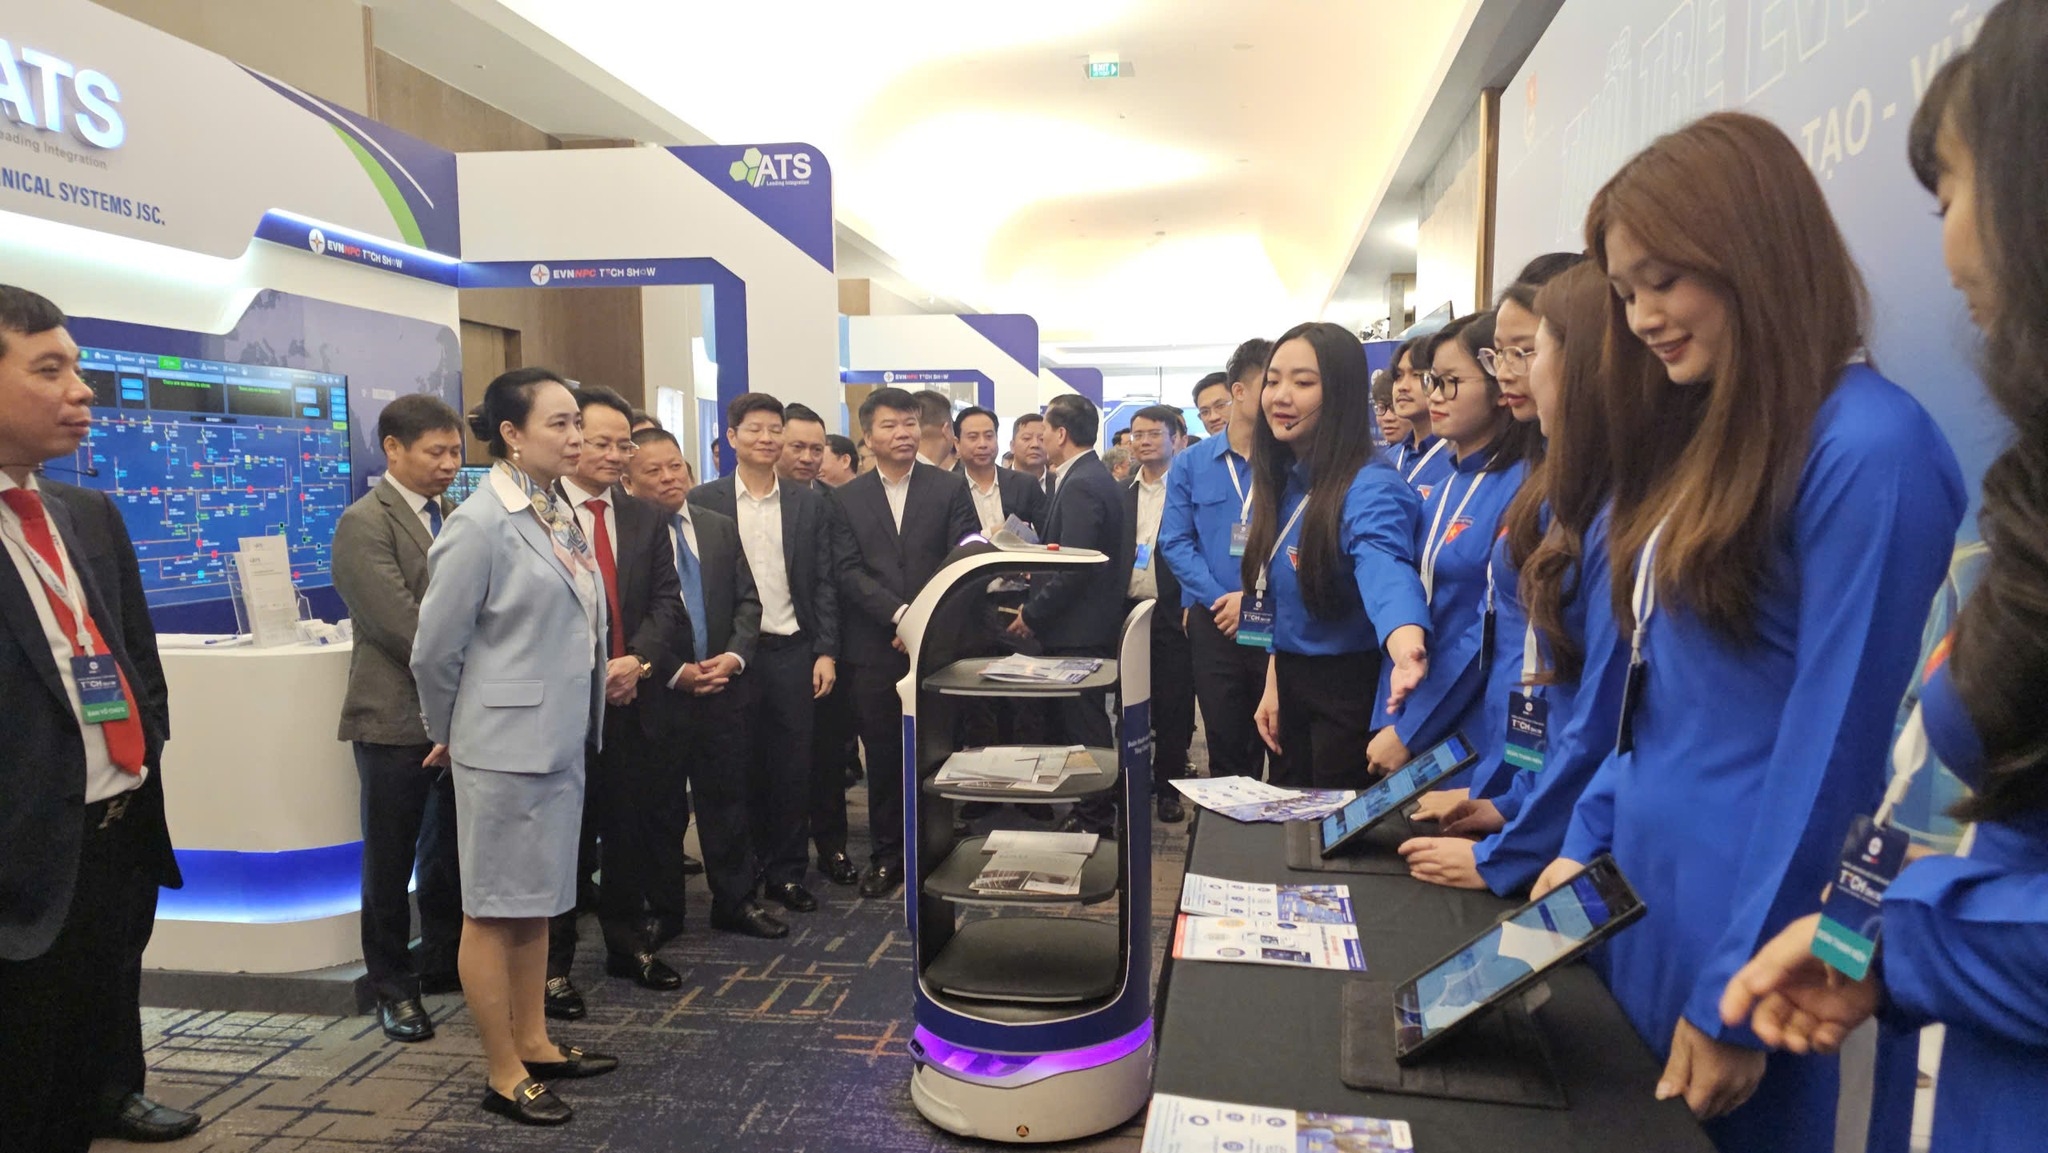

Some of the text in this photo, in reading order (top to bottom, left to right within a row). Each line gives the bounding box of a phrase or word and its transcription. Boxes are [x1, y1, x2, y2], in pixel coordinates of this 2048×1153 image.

[0, 38, 126, 150] ATS
[44, 142, 108, 170] Integration
[1801, 88, 1873, 181] TẠO
[754, 153, 812, 188] ATS
[0, 167, 166, 226] NICAL SYSTEMS JSC.
[553, 268, 597, 279] EVNNPC
